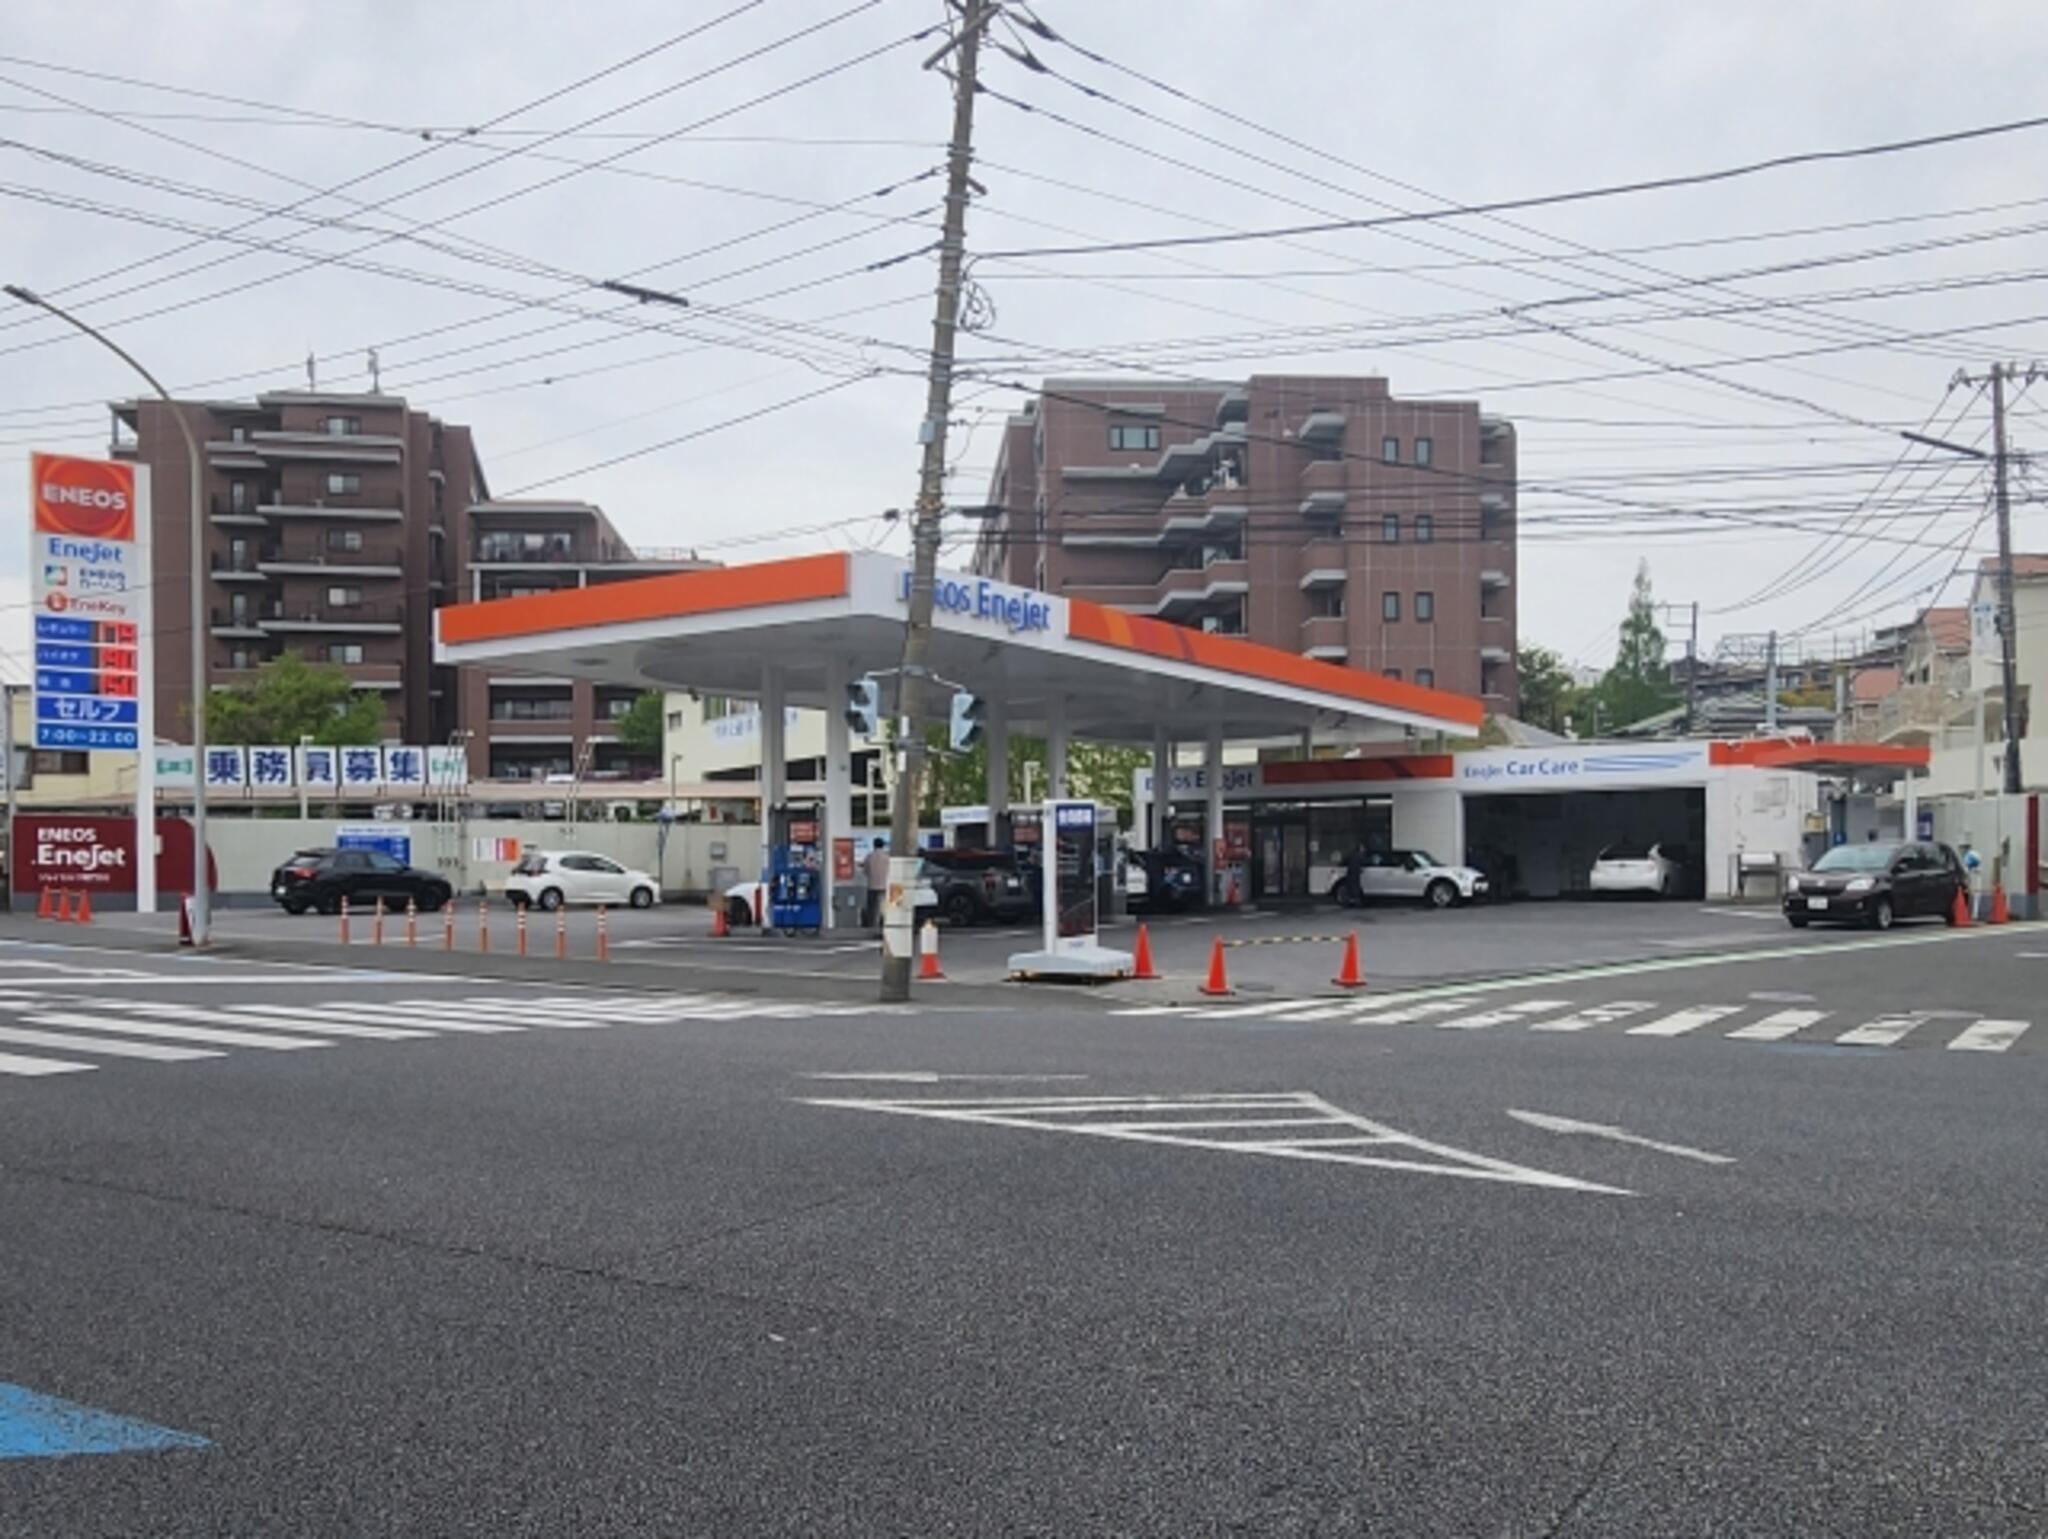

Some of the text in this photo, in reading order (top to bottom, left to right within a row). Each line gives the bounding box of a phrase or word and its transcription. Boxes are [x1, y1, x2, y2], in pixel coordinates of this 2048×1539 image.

[43, 485, 127, 510] ENEOS
[54, 698, 121, 721] セルフ
[208, 751, 418, 783] 乗務員募集
[1506, 761, 1536, 776] Car
[1538, 759, 1579, 775] Care
[38, 827, 97, 842] ENEOS
